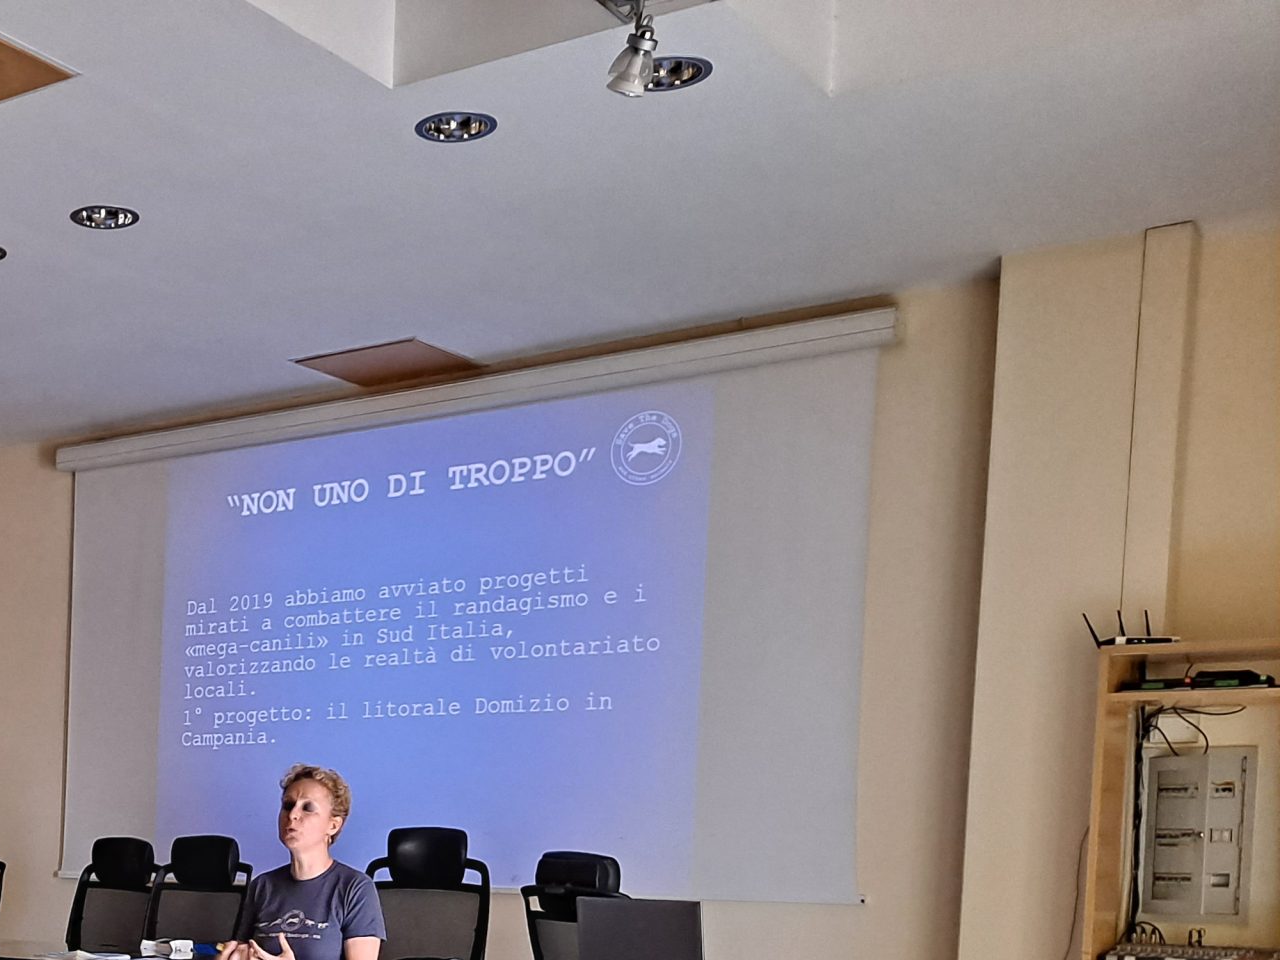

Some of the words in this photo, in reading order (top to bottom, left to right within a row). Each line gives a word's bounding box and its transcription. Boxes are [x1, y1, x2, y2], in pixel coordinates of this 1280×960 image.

[313, 478, 369, 507] UNO
[387, 471, 427, 498] DI
[187, 598, 217, 616] Dal
[229, 593, 273, 612] 2019
[284, 587, 366, 607] abbiamo
[378, 578, 466, 599] avviato
[479, 564, 589, 595] progetti
[184, 616, 249, 637] mirati
[261, 618, 272, 630] a
[283, 607, 401, 629] combattere
[415, 600, 438, 619] il
[453, 592, 589, 615] randagismo
[603, 590, 617, 604] e
[634, 584, 647, 602] i
[184, 656, 316, 678] valorizzando
[328, 653, 351, 670] le
[363, 647, 437, 668] realtà
[450, 644, 476, 662] di
[490, 635, 660, 660] volontariato
[185, 632, 328, 658] «mega-canili»
[341, 630, 364, 647] in
[376, 625, 413, 644] Sud
[427, 619, 513, 641] Italia,
[184, 680, 256, 699] locali.
[213, 706, 312, 728] progetto:
[326, 702, 349, 720] il
[362, 698, 461, 719] litorale
[474, 693, 569, 715] Domizio
[585, 692, 613, 711] in
[181, 728, 276, 750] Campania.
